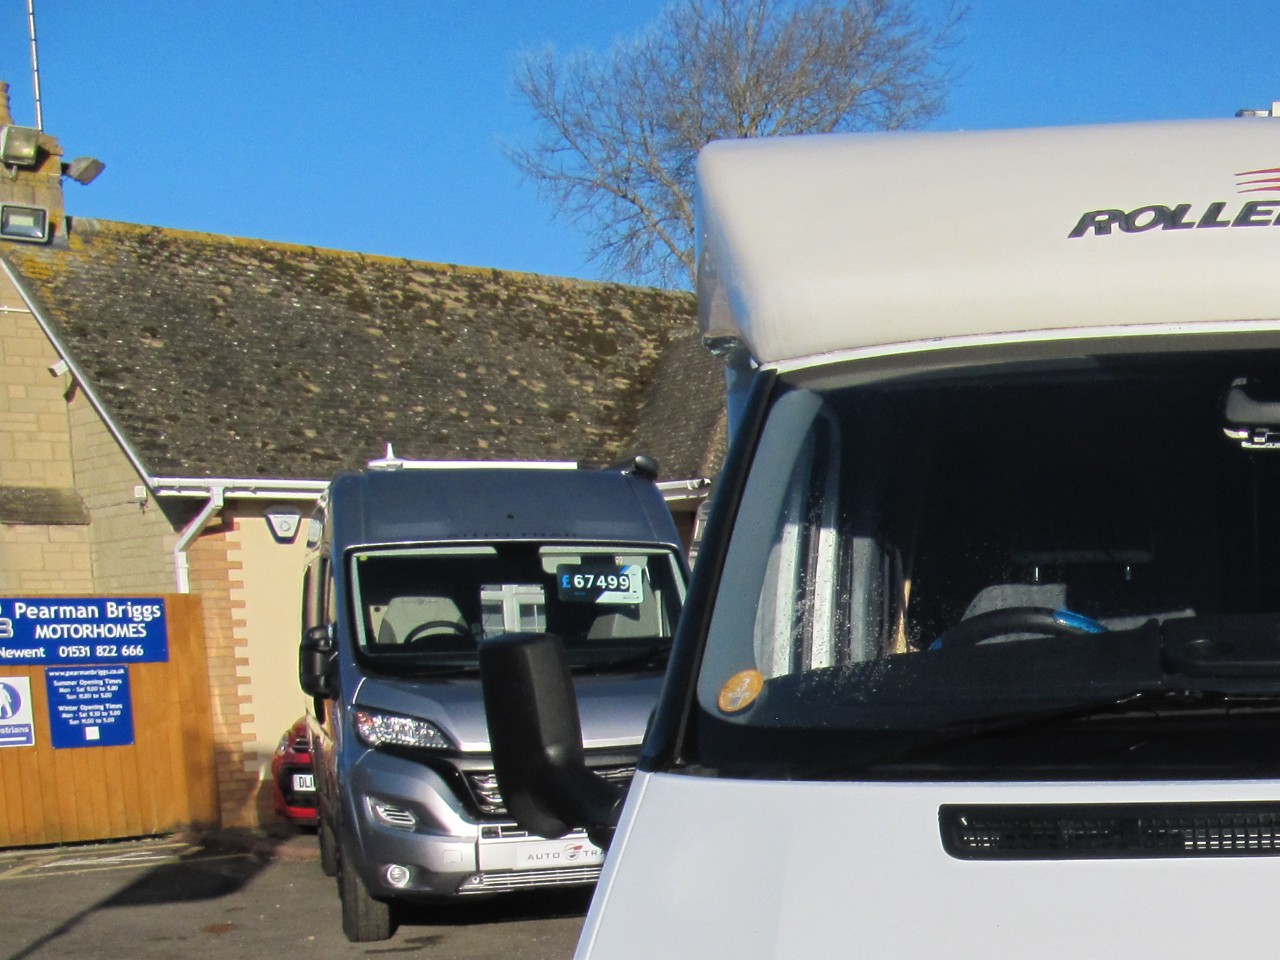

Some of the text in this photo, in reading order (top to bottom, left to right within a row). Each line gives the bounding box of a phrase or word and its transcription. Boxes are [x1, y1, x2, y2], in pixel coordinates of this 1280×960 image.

[15, 602, 161, 621] Pearman Briggs
[35, 623, 147, 639] MOTORHOMES
[59, 645, 90, 657] 01531
[96, 645, 118, 657] 822
[122, 645, 144, 656] 666
[527, 852, 560, 861] AUTO
